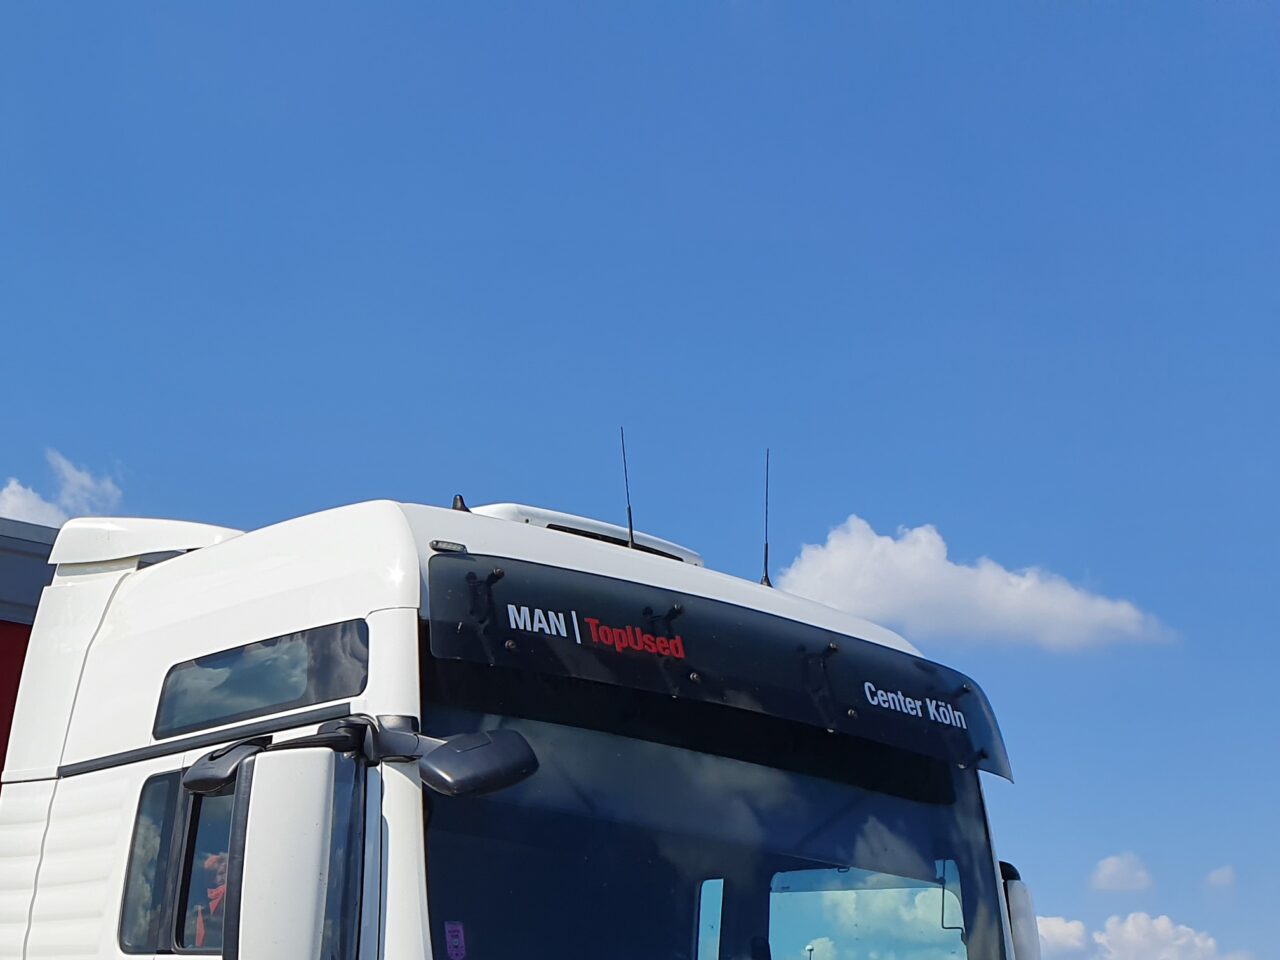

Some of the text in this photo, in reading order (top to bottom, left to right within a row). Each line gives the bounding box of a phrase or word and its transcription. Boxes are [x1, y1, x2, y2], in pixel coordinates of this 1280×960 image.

[507, 604, 686, 660] MAN TopUsed
[864, 681, 968, 730] Center Köln
